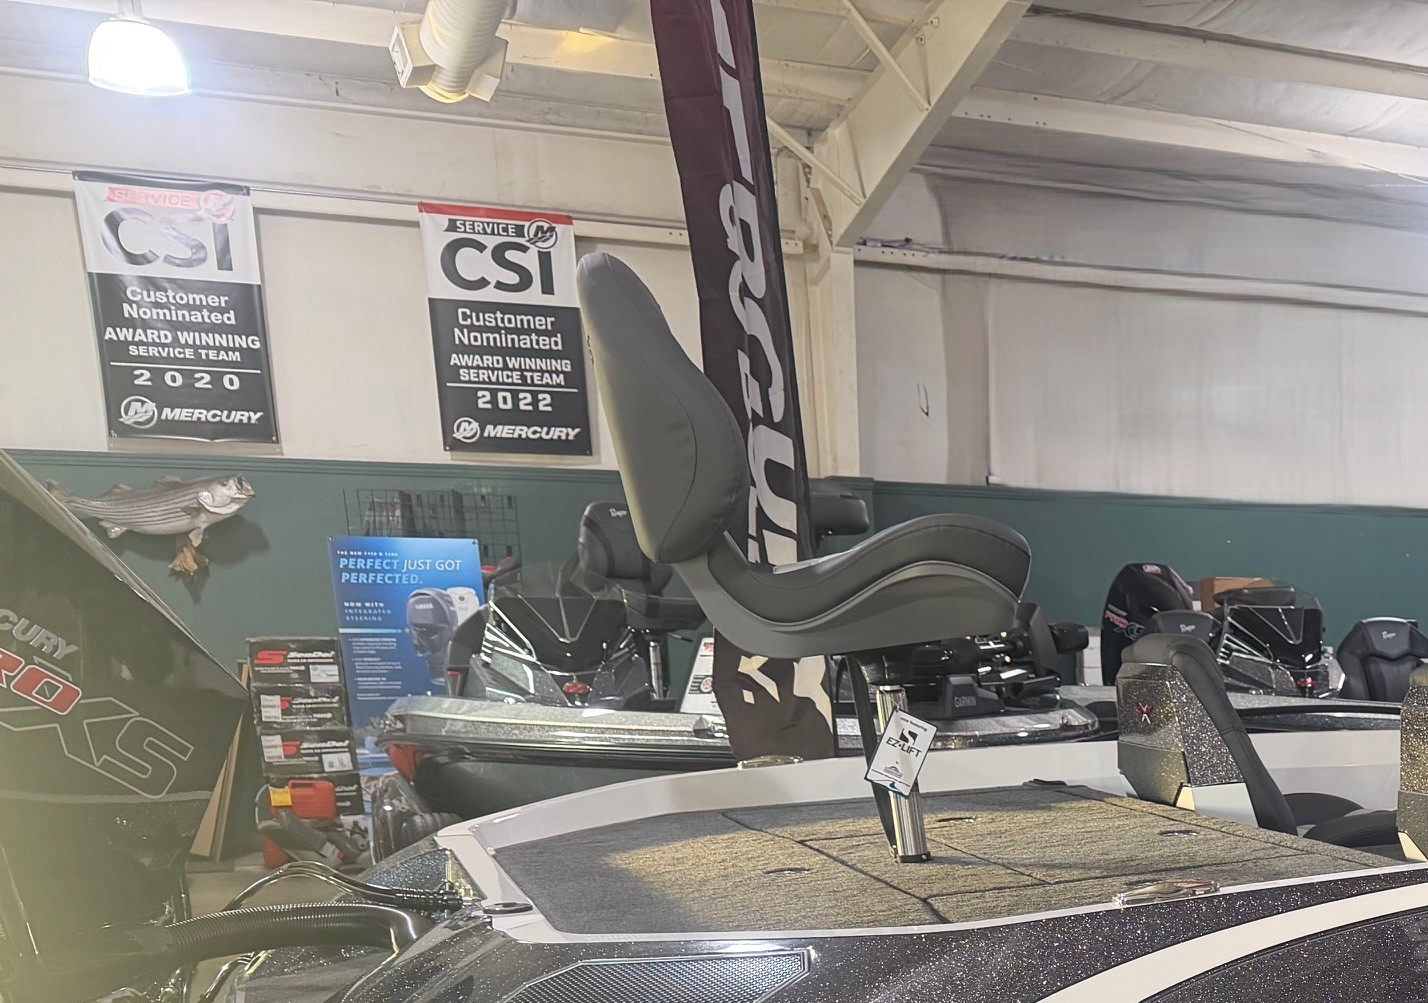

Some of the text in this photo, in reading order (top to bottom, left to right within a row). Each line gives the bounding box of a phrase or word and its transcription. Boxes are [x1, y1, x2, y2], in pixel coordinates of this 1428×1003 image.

[455, 218, 518, 237] SERVICE
[101, 207, 235, 272] CSI
[440, 238, 556, 296] CSI
[126, 286, 230, 308] Customer
[122, 302, 236, 326] Nominated
[457, 308, 556, 331] Customer
[104, 327, 262, 350] AWARD WINNING
[453, 328, 563, 352] Nominated
[128, 345, 242, 363] SERVICE TEAM
[449, 353, 572, 373] AWARD WINNING
[459, 368, 565, 387] SERVICE TEAM
[476, 390, 554, 413] 2022
[160, 406, 263, 426] MERCURY
[483, 424, 581, 442] MERCURY
[339, 558, 463, 573] PERFECT JUST GOT
[341, 572, 423, 584] PERFECTED.
[0, 608, 79, 661] CURY
